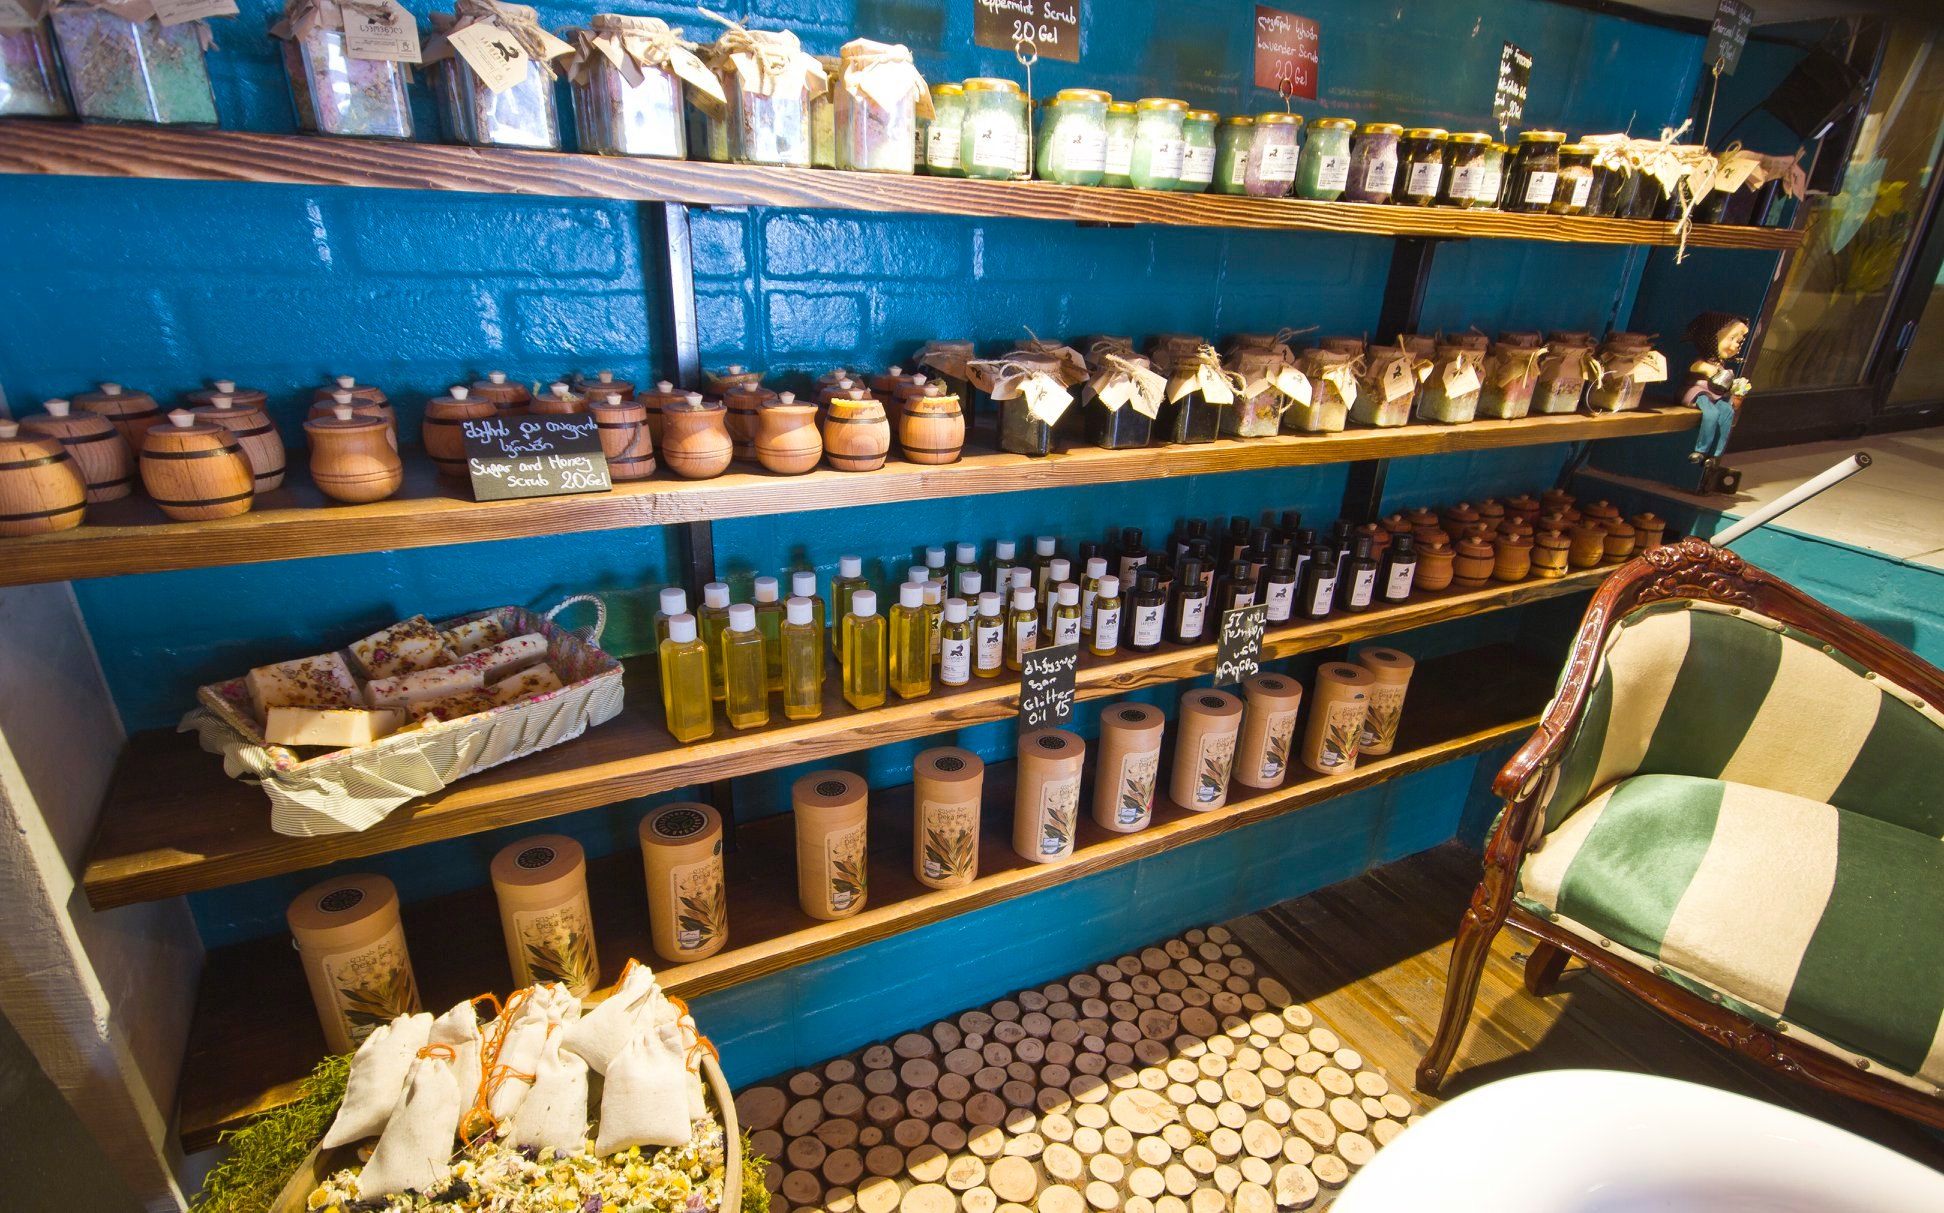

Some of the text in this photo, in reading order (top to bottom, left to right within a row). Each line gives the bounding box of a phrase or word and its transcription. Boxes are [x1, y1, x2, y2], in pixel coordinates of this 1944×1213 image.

[978, 0, 1077, 25] eppermint Scrub
[1012, 20, 1058, 44] 20 Gel
[1257, 33, 1318, 63] Lavender Scrub
[1275, 60, 1308, 86] 20 Gel
[520, 422, 540, 439] და
[470, 454, 593, 478] Sugar and Honey
[1247, 612, 1267, 624] Tan
[1225, 625, 1263, 646] Natural
[1023, 688, 1075, 711] Glitter
[1028, 698, 1071, 725] Oil 15
